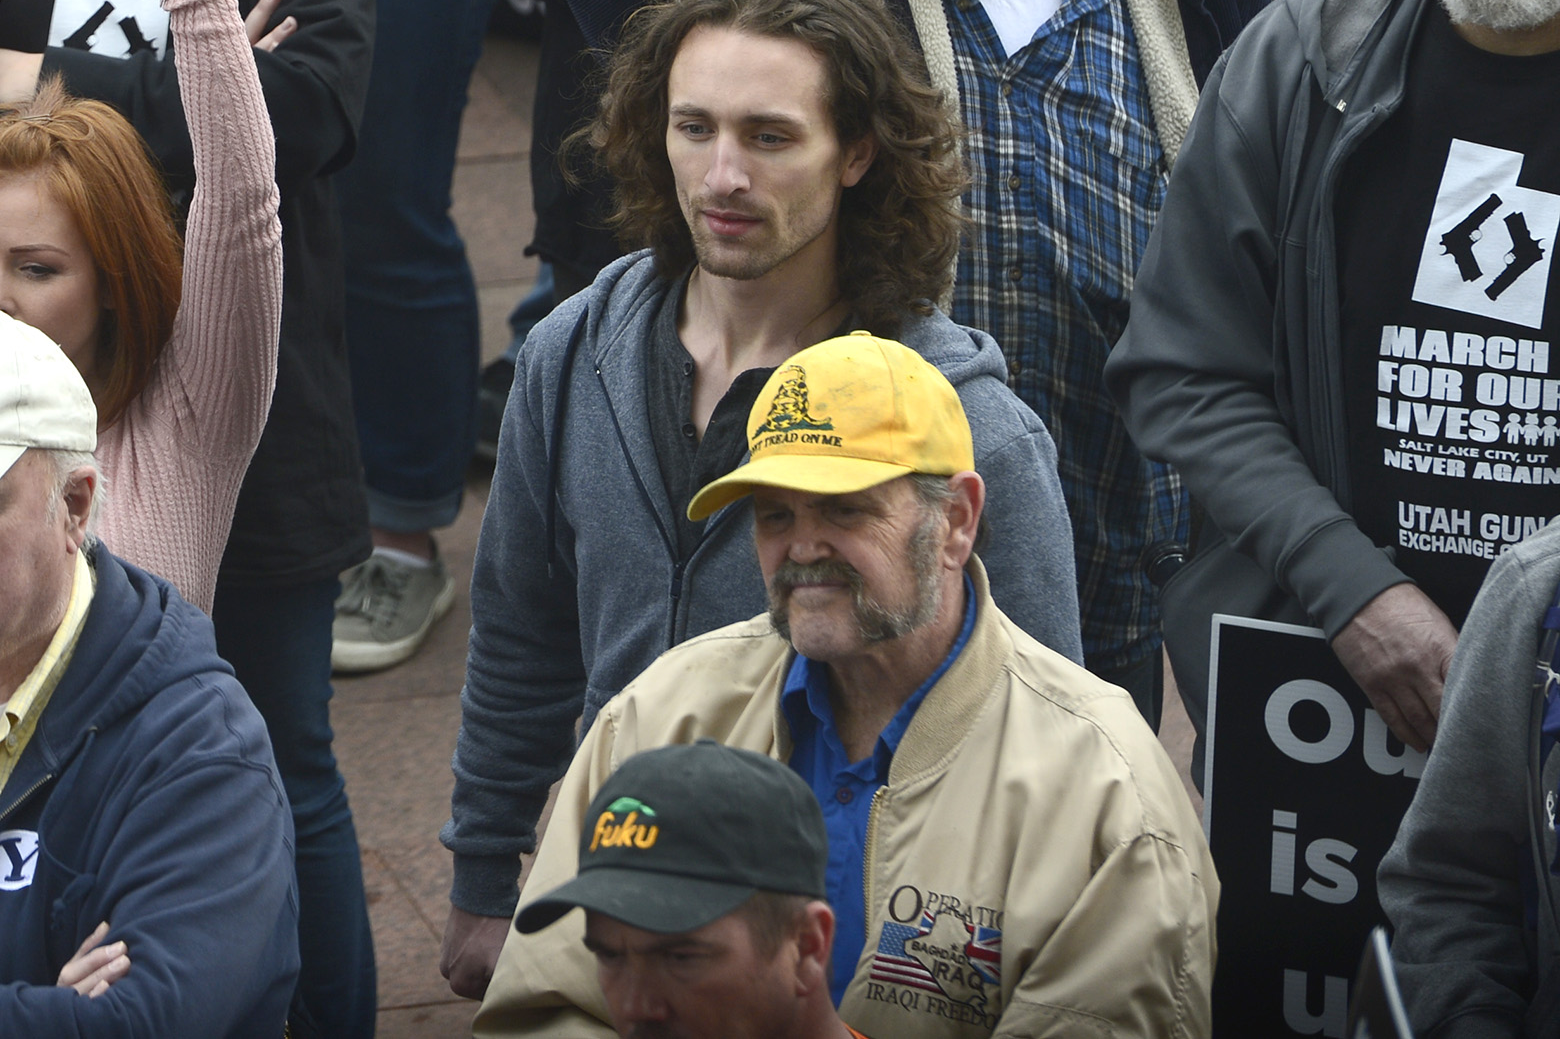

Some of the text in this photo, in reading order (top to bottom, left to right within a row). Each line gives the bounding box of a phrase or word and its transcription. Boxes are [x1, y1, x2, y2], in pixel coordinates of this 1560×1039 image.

[1379, 325, 1550, 374] MARCH
[1377, 360, 1463, 402] FOR
[1376, 396, 1501, 443] LIVES
[801, 433, 820, 445] ON
[822, 434, 843, 447] ME
[1398, 438, 1434, 453] SALT
[1438, 444, 1480, 458] LAKE
[1526, 454, 1549, 464] UT
[1383, 448, 1466, 478] NEVER
[1398, 500, 1471, 536] UTAH
[1264, 679, 1425, 780] Ou
[1270, 809, 1359, 904] is
[911, 940, 967, 965] BAGHDAD
[932, 958, 985, 992] IRAQ
[866, 981, 920, 1012] IRAQI
[1283, 968, 1349, 1039] u
